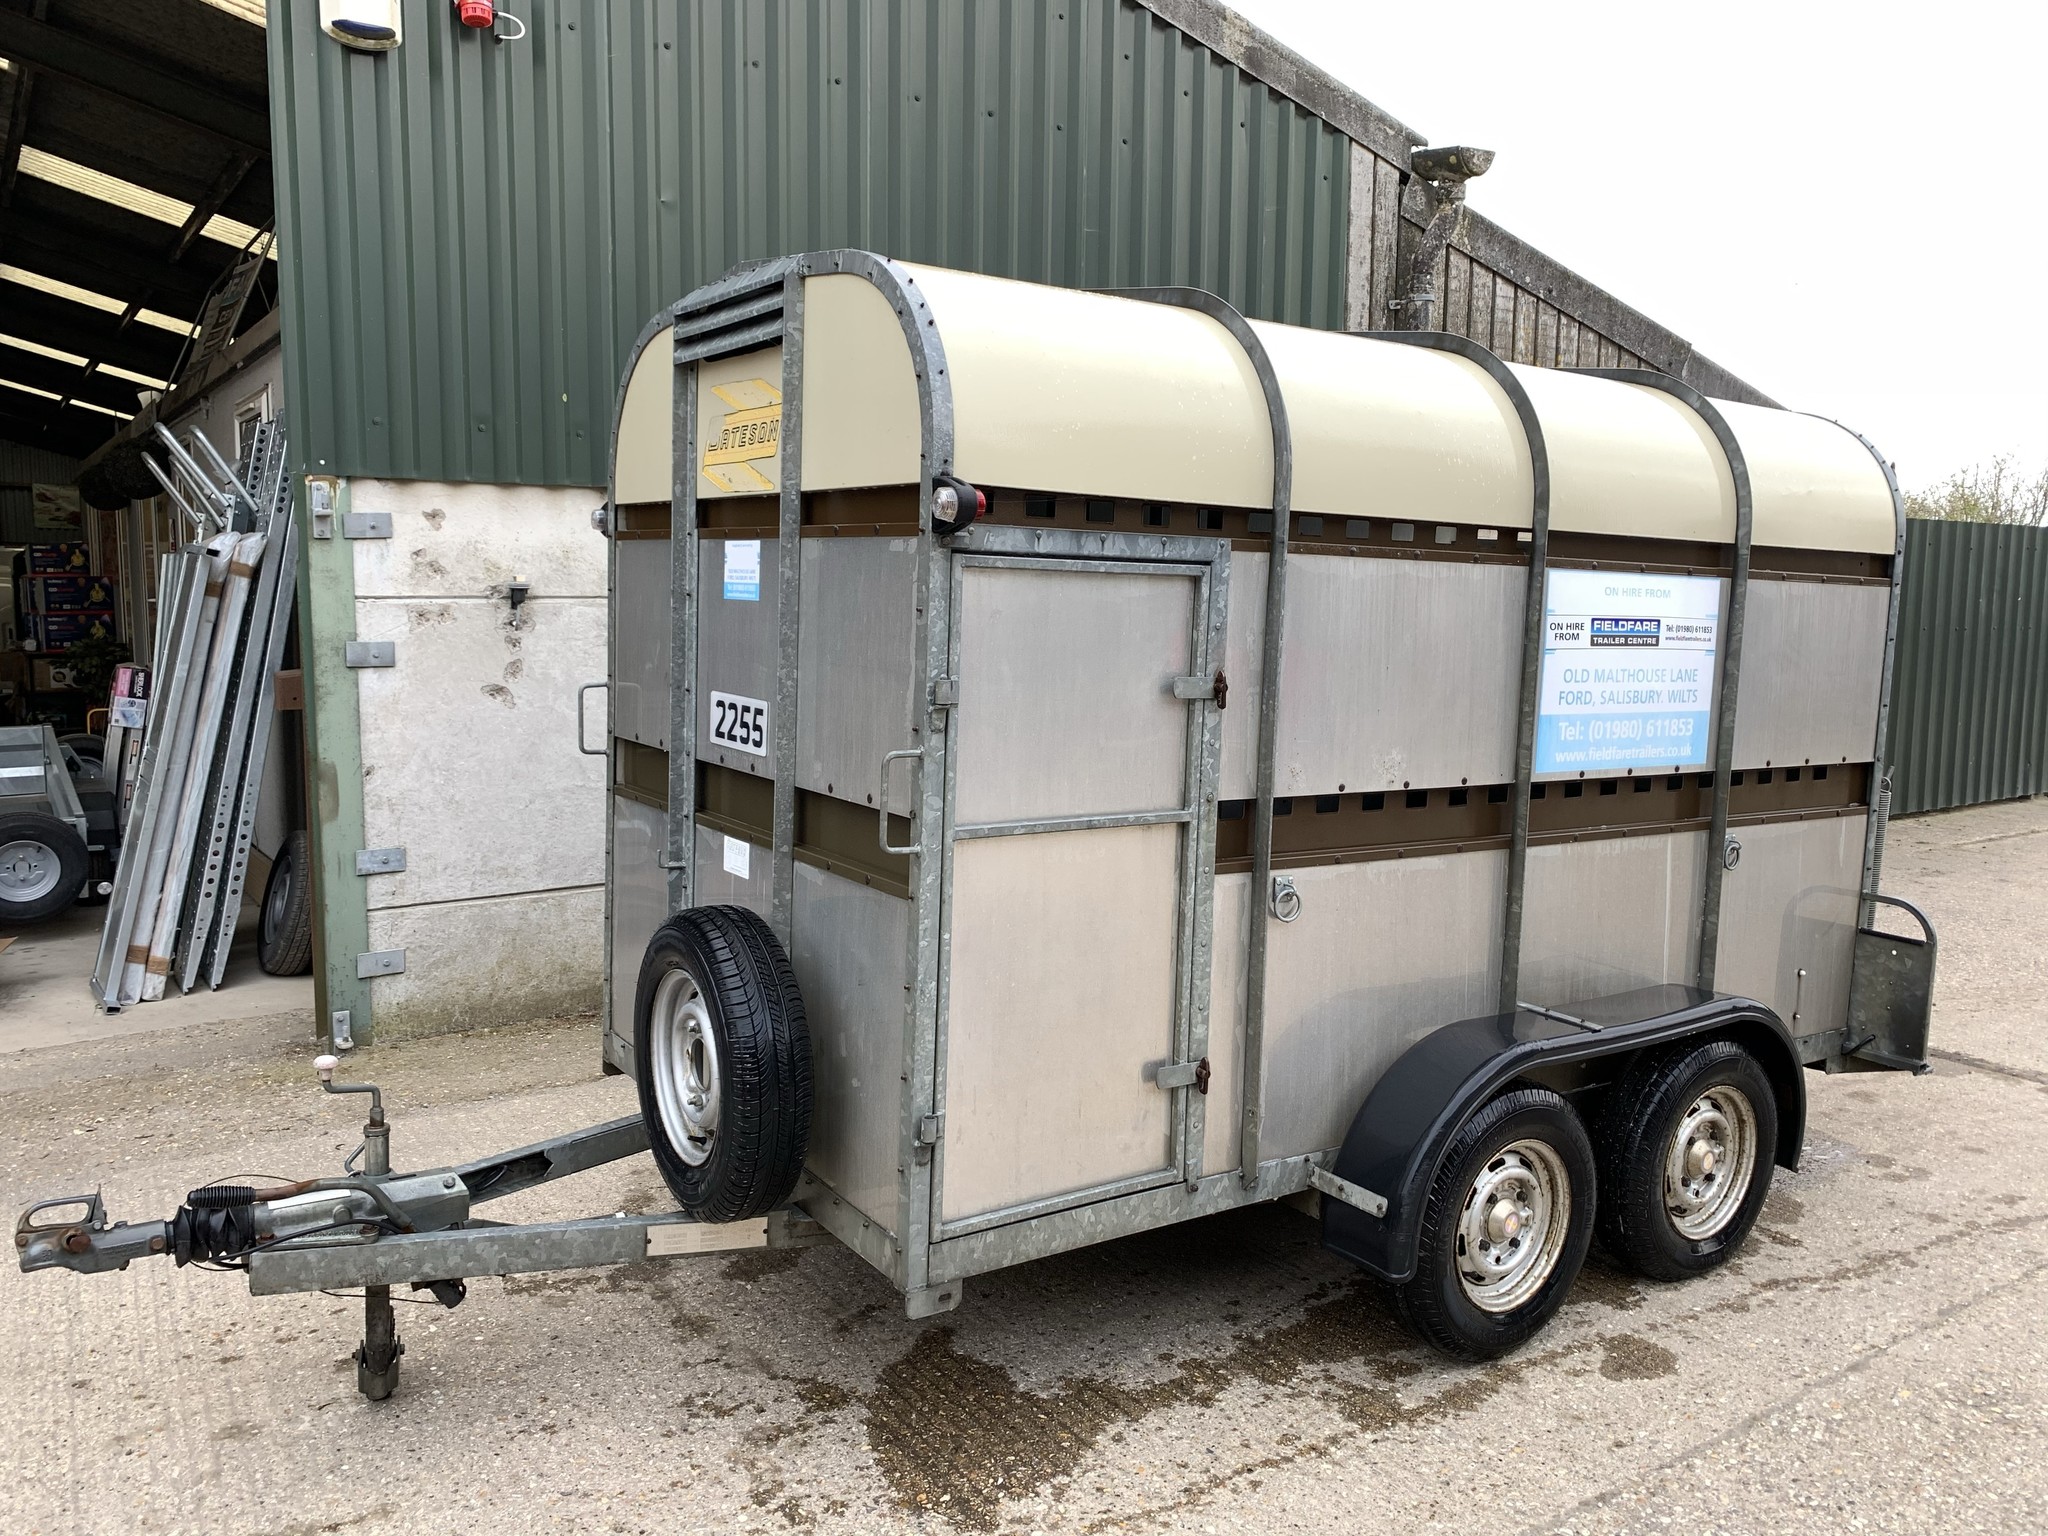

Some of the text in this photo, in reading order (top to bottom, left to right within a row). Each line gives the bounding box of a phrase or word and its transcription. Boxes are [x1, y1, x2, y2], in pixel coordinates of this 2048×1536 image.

[1604, 586, 1672, 599] ON HIRE FROM
[1549, 622, 1585, 631] ON HIRE
[1593, 620, 1659, 632] FIELDFARE
[1665, 624, 1713, 634] Tel: (01980) 611853
[1554, 632, 1580, 641] FROM
[1593, 637, 1657, 645] TRAILER CENTRE
[1563, 668, 1699, 684] OLD MALTHOUSE LANE
[1558, 690, 1596, 707] FORD,
[1667, 688, 1698, 704] WILTS
[715, 699, 763, 749] 2255
[1558, 717, 1694, 743] Tel: (01980) 611853
[1555, 743, 1693, 763] www.fieldfaretrailers.co.uk
